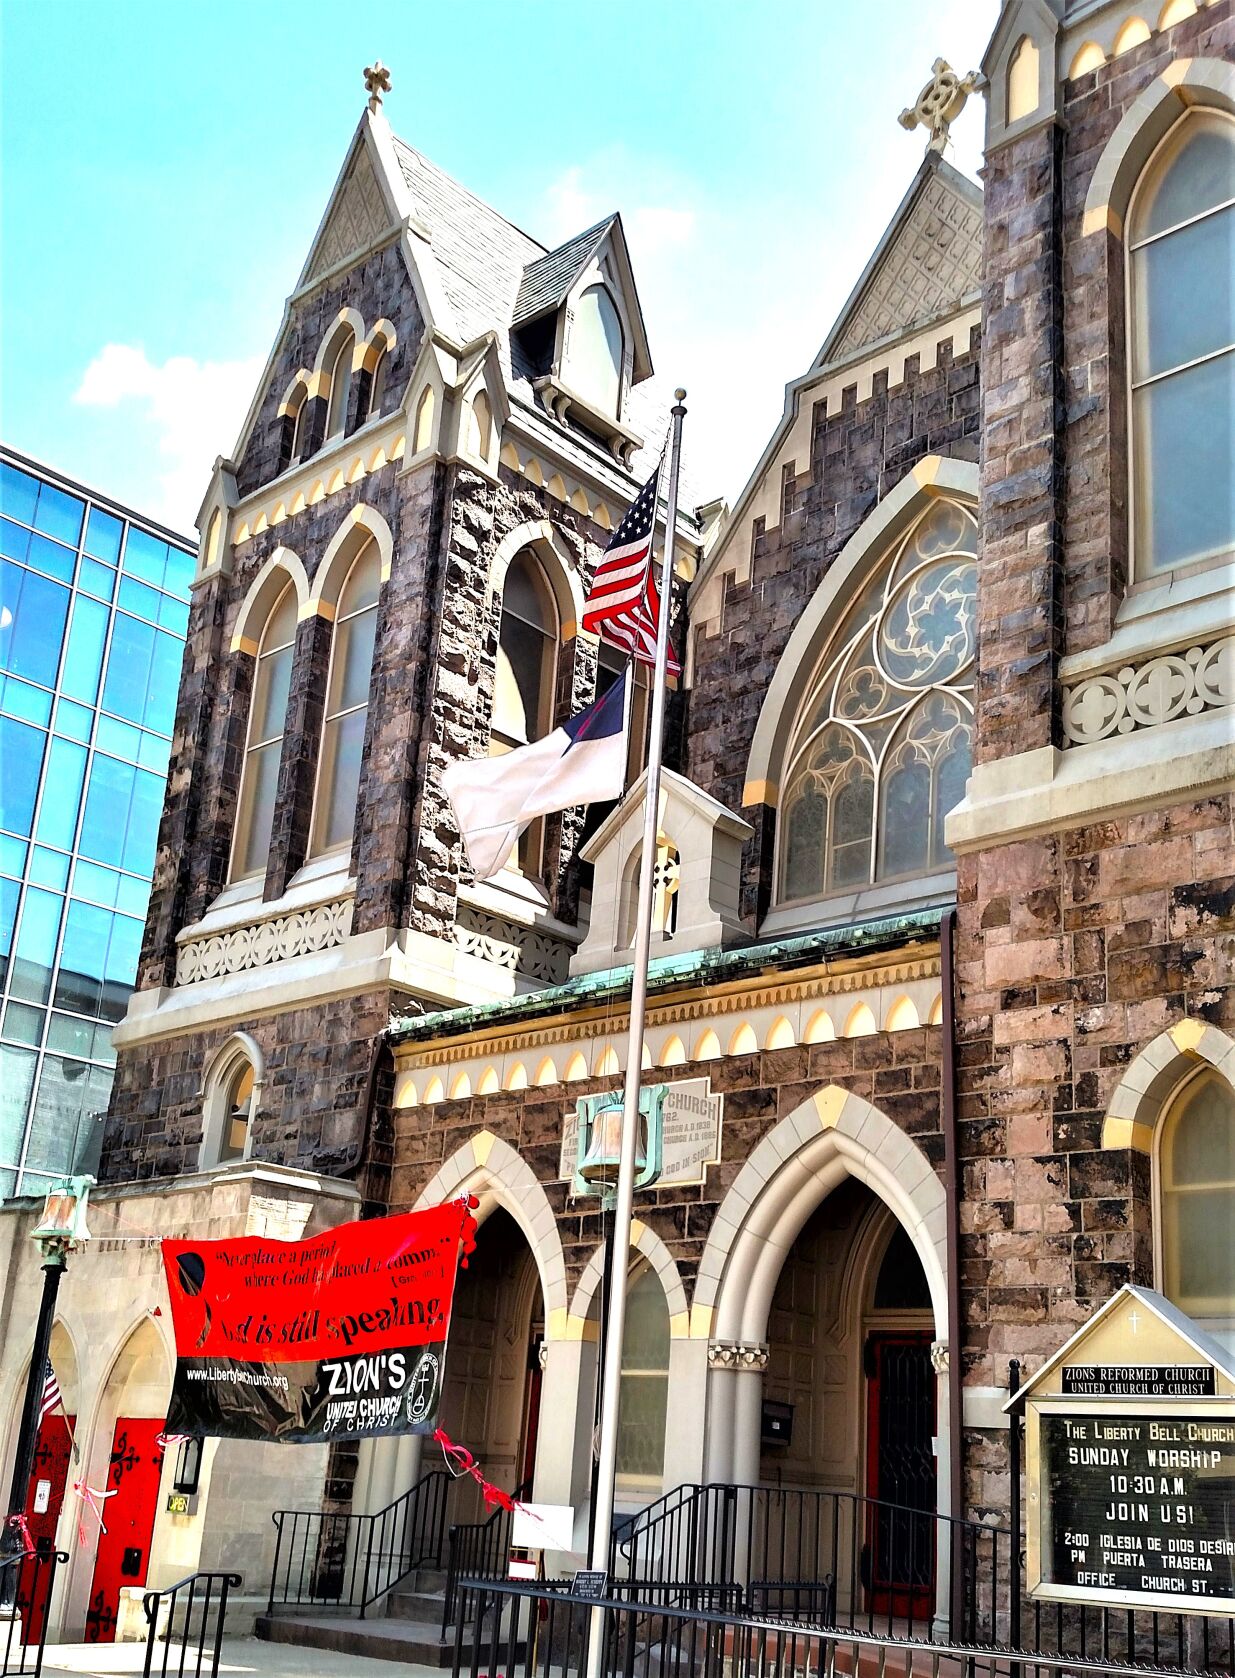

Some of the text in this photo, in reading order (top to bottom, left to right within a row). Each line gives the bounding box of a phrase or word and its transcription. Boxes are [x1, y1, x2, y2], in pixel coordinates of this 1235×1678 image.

[667, 1092, 716, 1121] CHURCH
[662, 1124, 684, 1135] HURCH
[256, 1314, 276, 1344] is
[277, 1309, 320, 1344] still
[322, 1353, 406, 1396] ZION'S
[1100, 1368, 1159, 1381] REFORMED
[1165, 1368, 1210, 1381] CHURCH
[1071, 1382, 1205, 1395] UNITED CHURCH OF CHRIST
[359, 1395, 403, 1417] CHURCH
[323, 1412, 399, 1433] OF CHRIST
[1069, 1447, 1221, 1469] SUNDAY WORSHIP
[1110, 1475, 1188, 1496] 10:30 A.M.
[169, 1497, 188, 1511] OPEN
[1105, 1502, 1194, 1524] JOIN US!
[1064, 1532, 1235, 1556] 2:00 IGLESIA DE DIOS DESIR
[1071, 1550, 1213, 1572] PM PUERTA TRASERA
[1077, 1571, 1214, 1594] OFFICE CHURCH ST.
